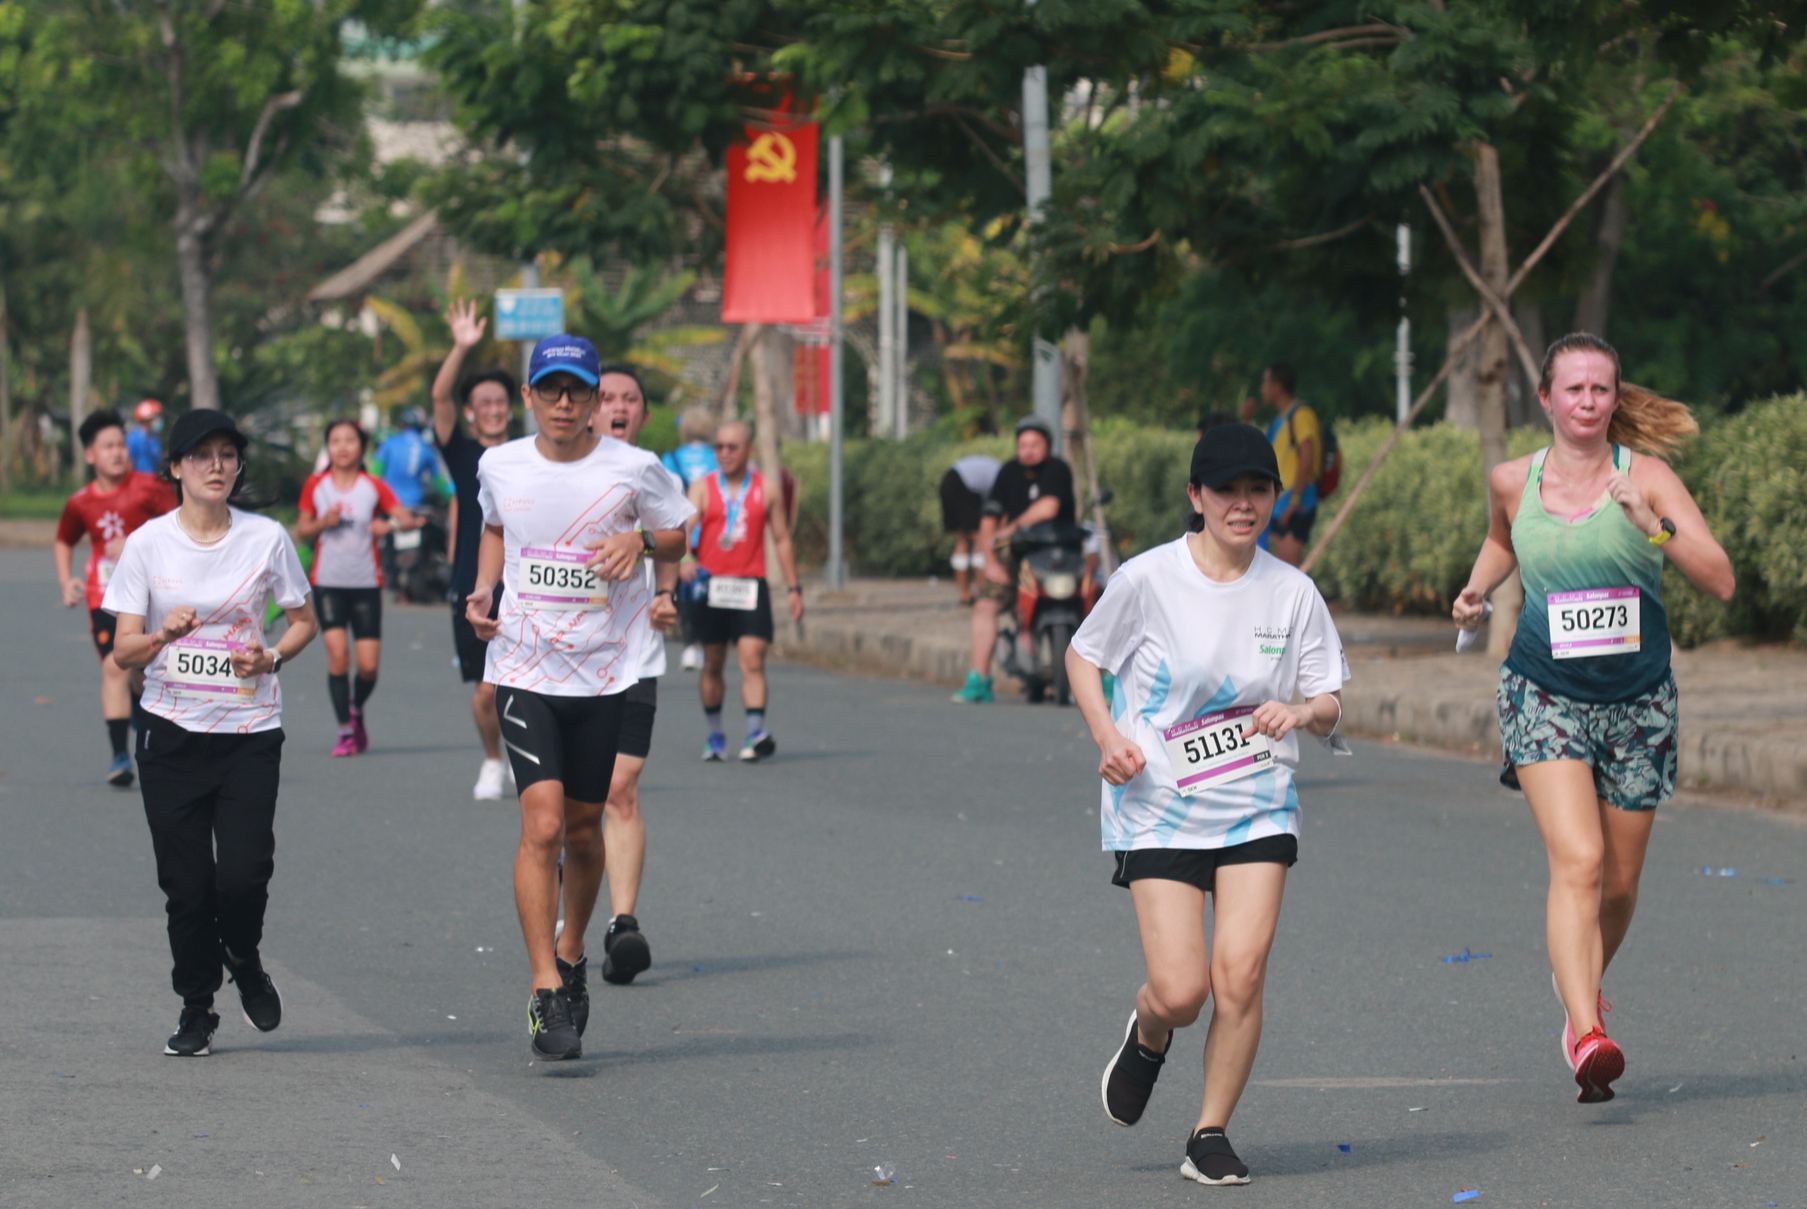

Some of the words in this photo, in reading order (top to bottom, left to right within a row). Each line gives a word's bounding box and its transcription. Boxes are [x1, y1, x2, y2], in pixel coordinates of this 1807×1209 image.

[529, 564, 596, 589] 50352
[1561, 605, 1628, 631] 50273
[178, 653, 239, 678] 5034
[1183, 723, 1250, 764] 51131
